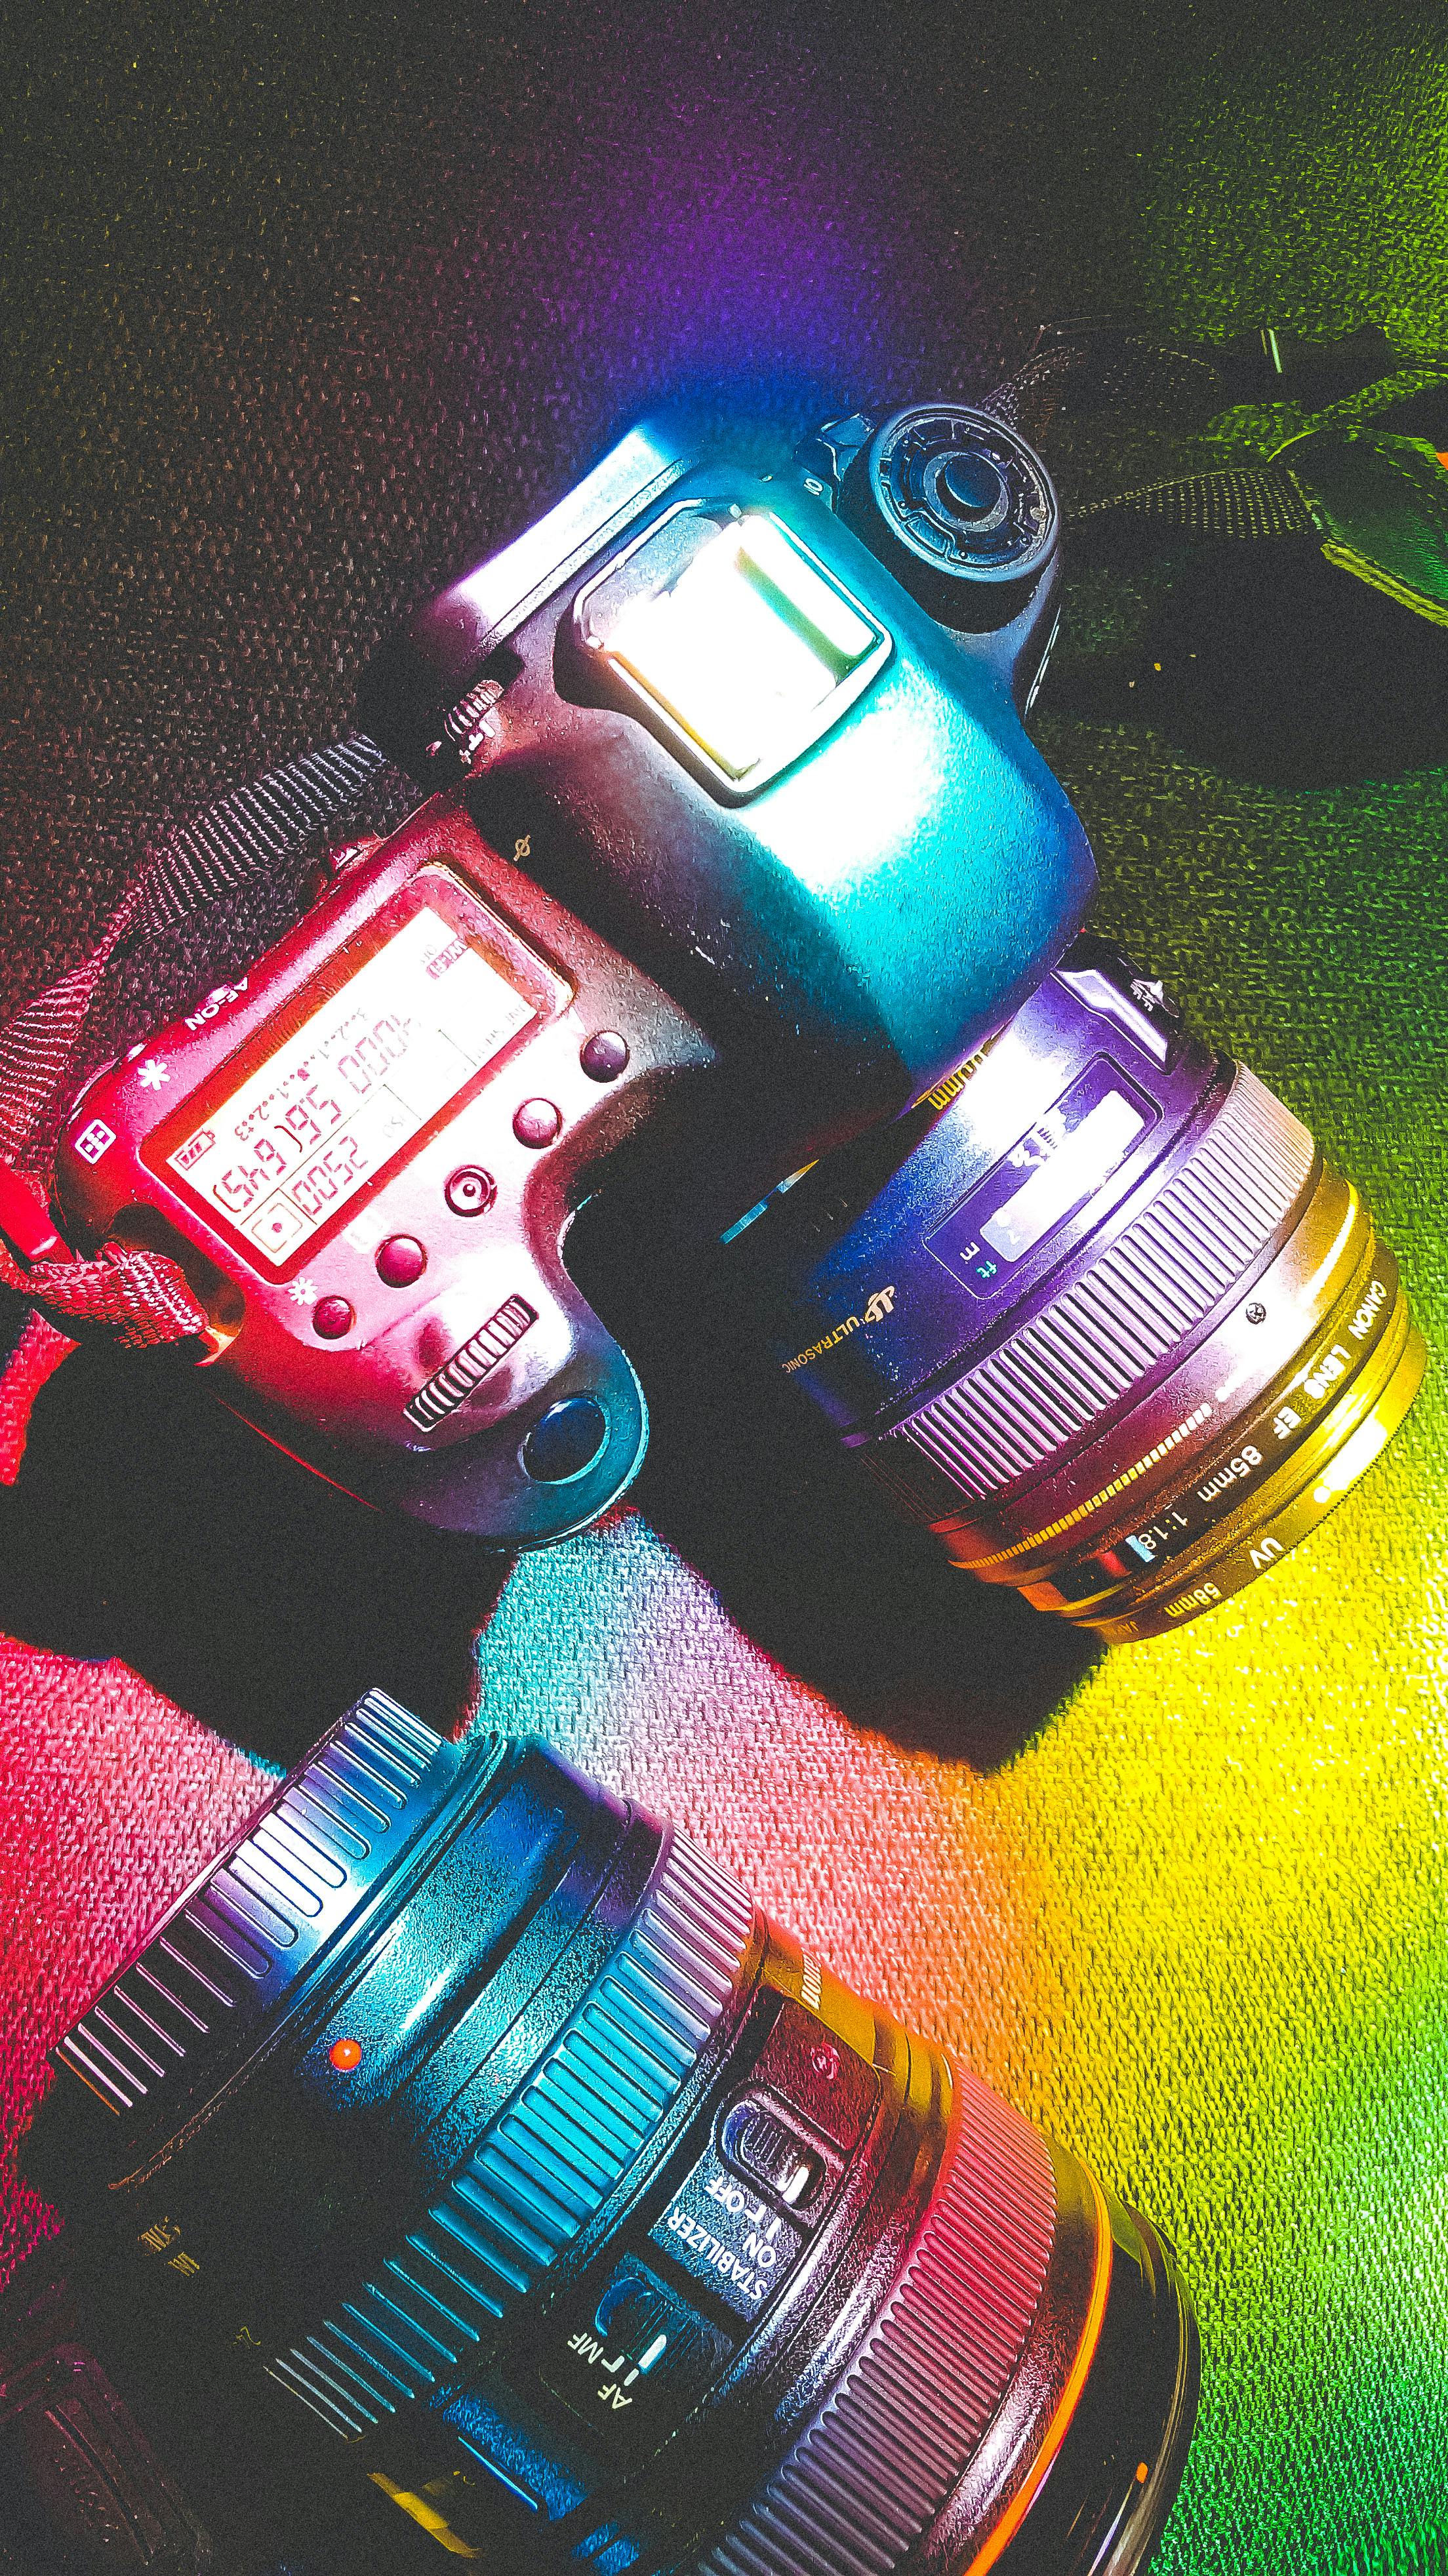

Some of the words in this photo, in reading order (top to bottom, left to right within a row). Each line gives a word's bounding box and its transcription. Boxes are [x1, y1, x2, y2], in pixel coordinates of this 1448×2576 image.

[185, 977, 249, 1031] AF-ON
[291, 1137, 368, 1216] 2500
[960, 1241, 980, 1260] m
[976, 1260, 997, 1279] ft
[1348, 1280, 1388, 1340] CANON
[782, 1317, 860, 1373] ULTRASONIC
[1304, 1344, 1352, 1399] LENS
[1273, 1405, 1302, 1439] EF
[1197, 1445, 1263, 1504] 85mm
[1138, 1510, 1188, 1550] 1:1.8
[1250, 1537, 1285, 1569] UV
[1165, 1582, 1222, 1619] 58mm
[704, 2173, 746, 2213] OFF
[668, 2210, 770, 2301] STABILIZER
[742, 2234, 777, 2269] ON
[567, 2331, 603, 2366] MF
[597, 2383, 634, 2410] AF
